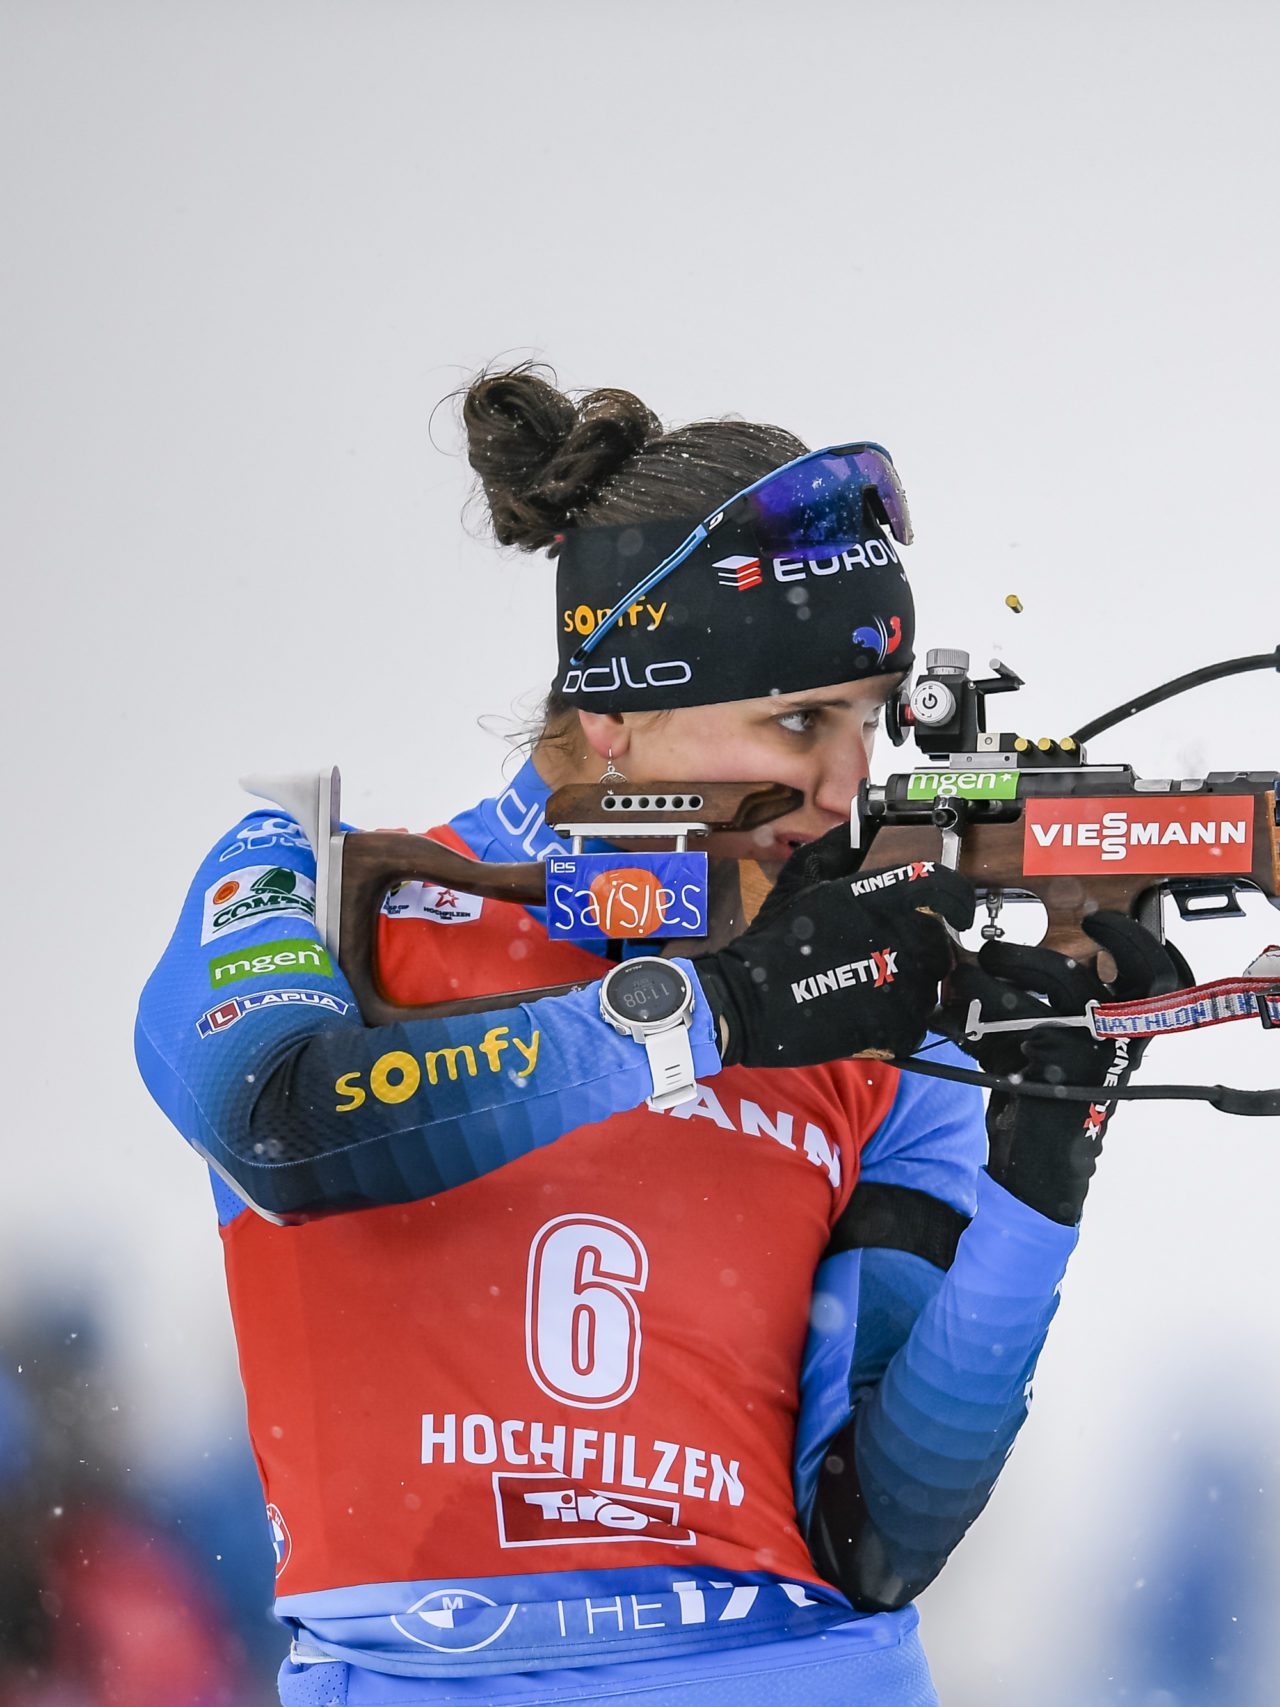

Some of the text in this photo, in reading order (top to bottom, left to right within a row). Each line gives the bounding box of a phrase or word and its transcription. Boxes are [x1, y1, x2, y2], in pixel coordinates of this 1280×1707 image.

[562, 656, 692, 693] odlo
[907, 773, 995, 797] mgen
[1030, 812, 1247, 861] VIESSMANN
[550, 859, 575, 874] les
[214, 950, 321, 980] mgen
[790, 947, 900, 1004] KINETIXX
[243, 993, 340, 1009] LAPUA
[335, 1026, 540, 1112] somfy
[525, 1213, 649, 1410] 6
[421, 1413, 745, 1507] HOCHFILZEN
[558, 1595, 666, 1637] THE
